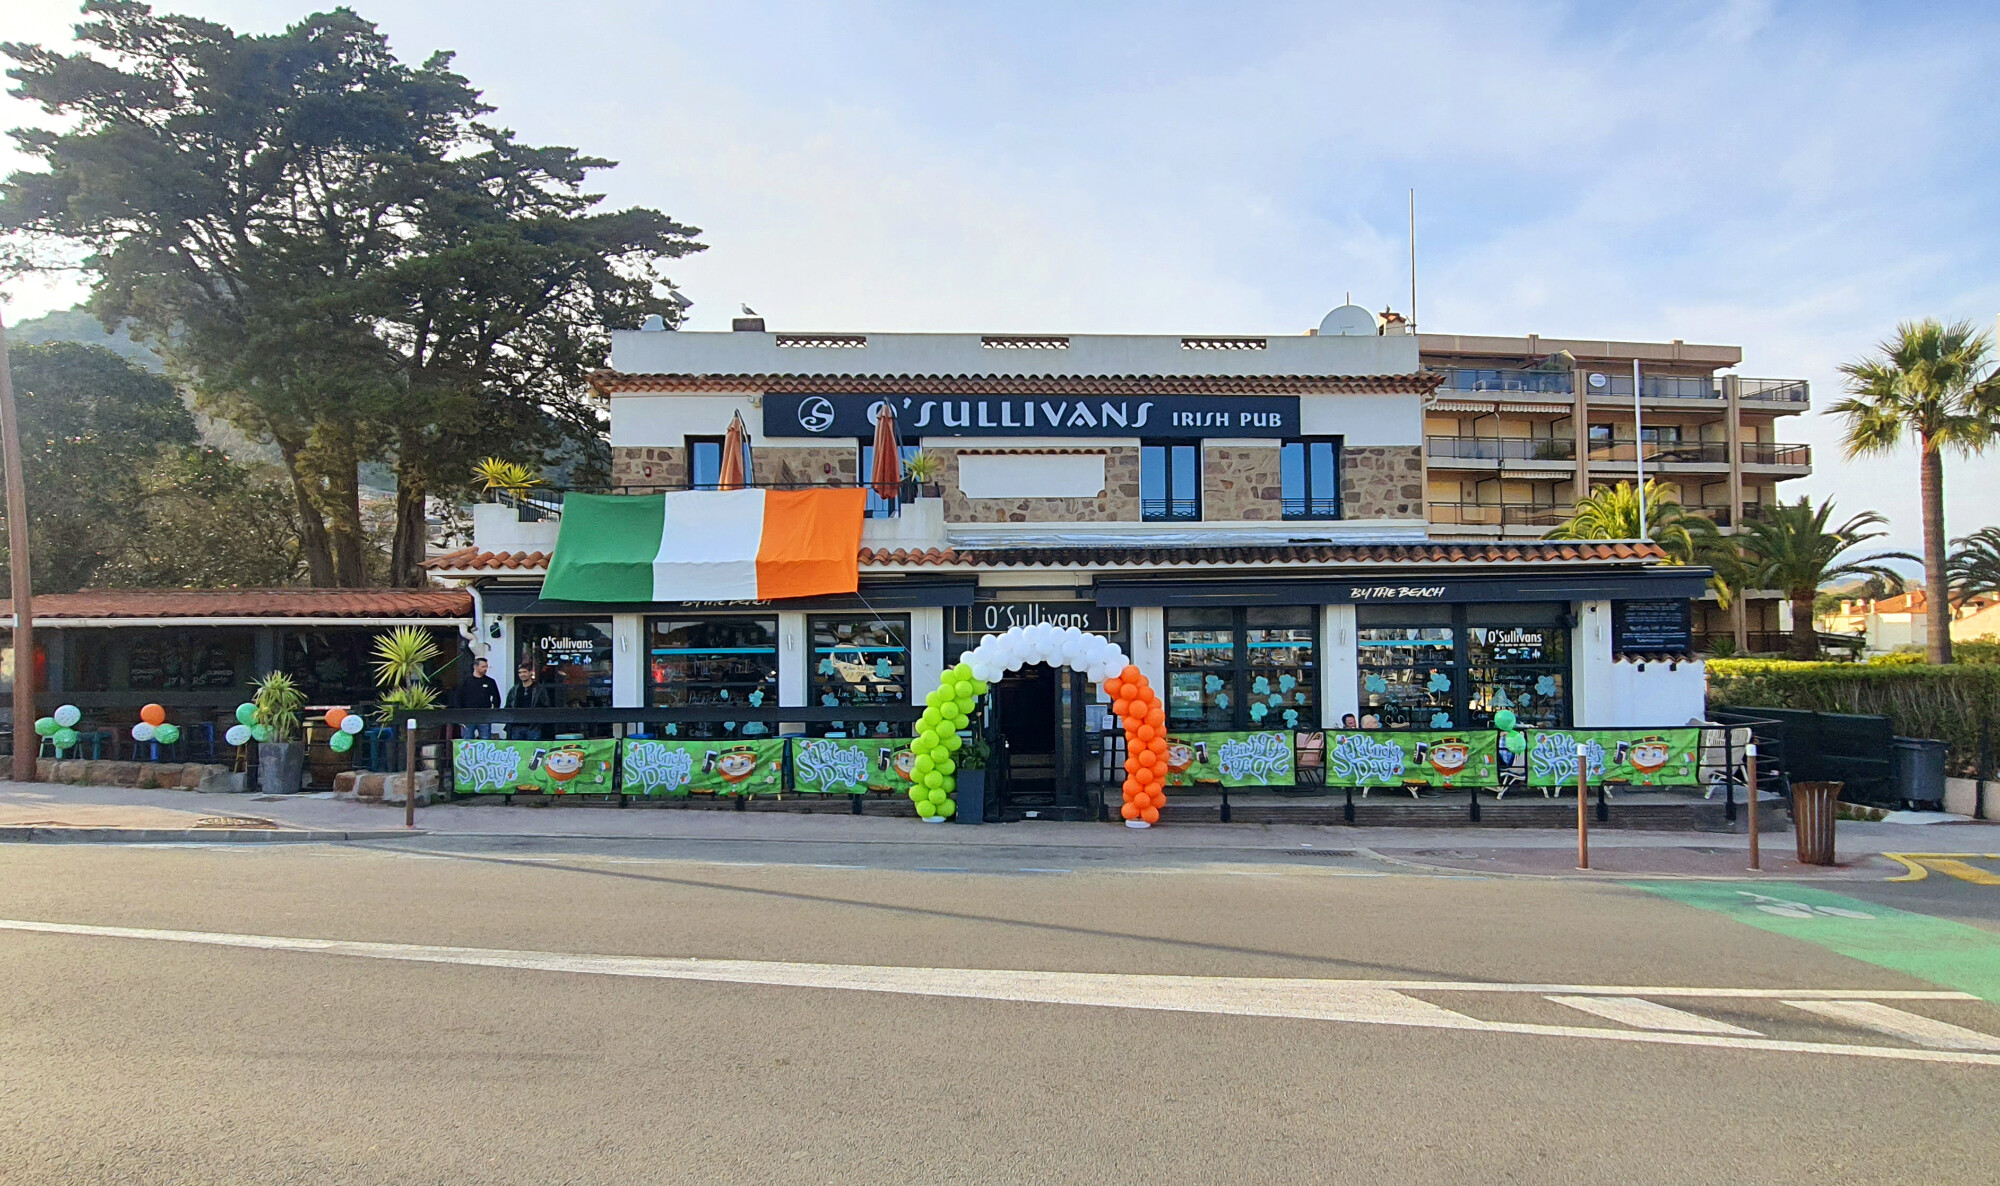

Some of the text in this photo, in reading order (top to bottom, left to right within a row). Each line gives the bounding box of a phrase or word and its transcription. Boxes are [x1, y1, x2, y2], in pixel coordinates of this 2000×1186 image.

[1172, 411, 1229, 426] IRISH
[1240, 412, 1282, 427] PUB
[1350, 586, 1446, 600] BY THE BEACH
[984, 603, 1090, 629] O'Sullivans
[540, 635, 594, 650] O'Sullivans
[1488, 629, 1543, 643] O'Sullivans
[473, 764, 507, 793] Day
[640, 766, 679, 795] Day
[818, 764, 857, 792] Day
[1351, 759, 1393, 786] Day
